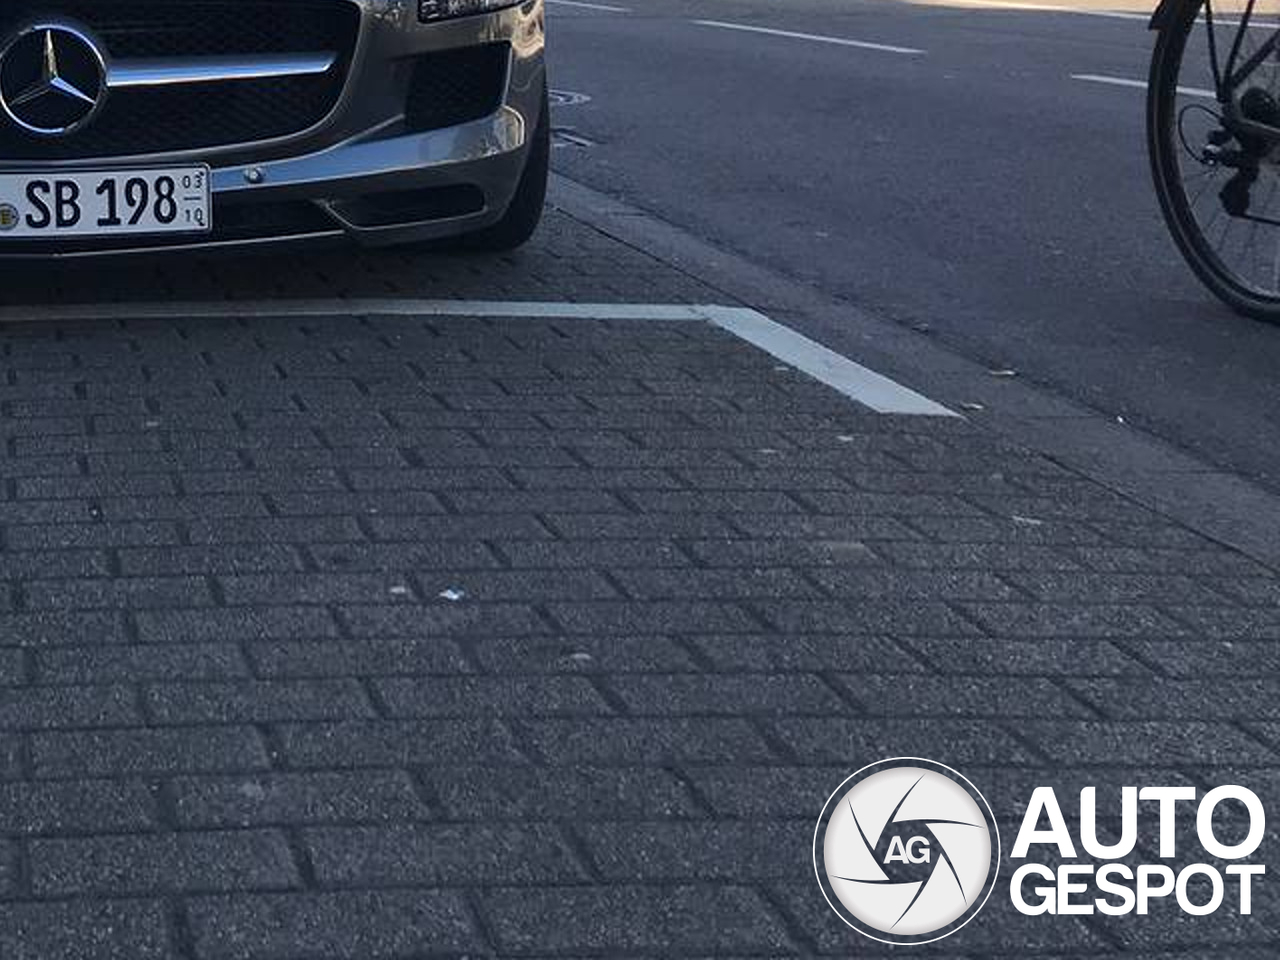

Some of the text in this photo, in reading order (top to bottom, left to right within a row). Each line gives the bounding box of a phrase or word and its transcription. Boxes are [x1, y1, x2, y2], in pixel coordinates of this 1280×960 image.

[182, 172, 204, 190] 03
[25, 179, 81, 228] SB
[95, 175, 177, 228] 198
